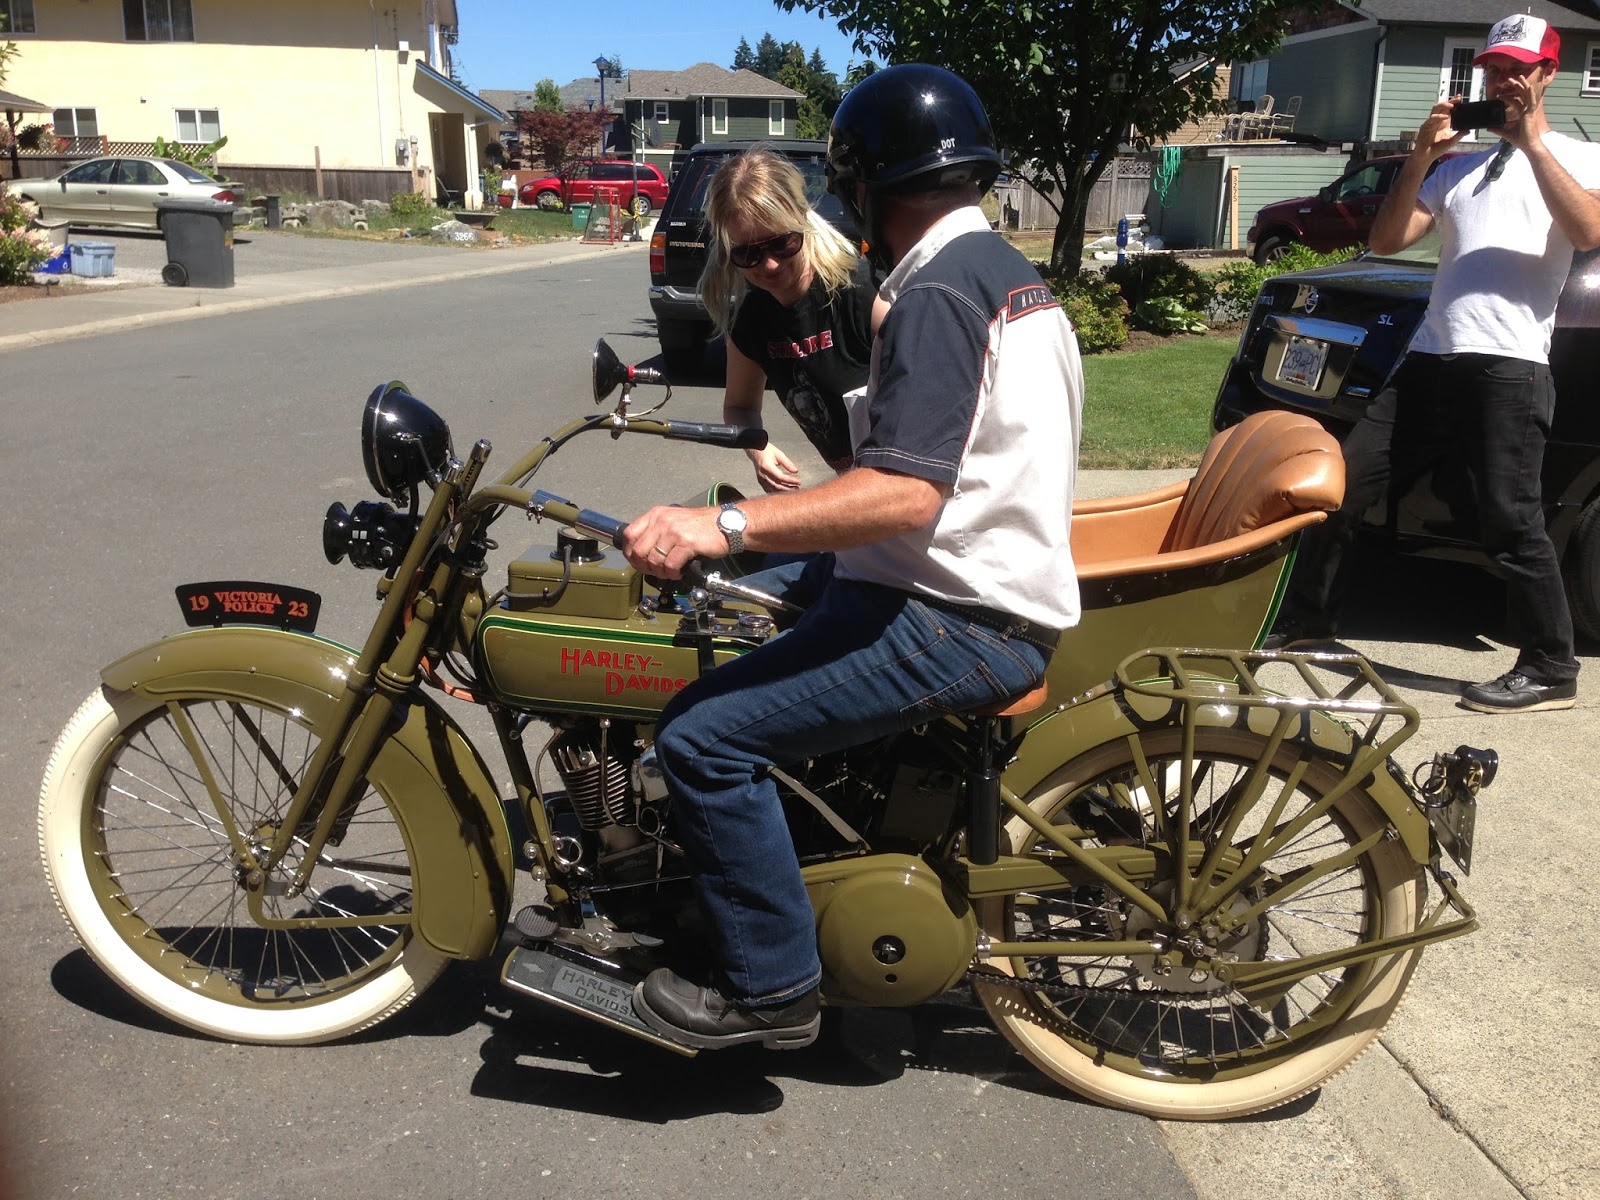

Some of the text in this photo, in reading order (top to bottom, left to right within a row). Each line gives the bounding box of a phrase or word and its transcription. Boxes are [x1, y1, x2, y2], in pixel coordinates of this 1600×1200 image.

[940, 137, 956, 150] DOT
[454, 231, 475, 242] 3266
[1377, 313, 1394, 326] SL
[189, 595, 210, 612] 19
[214, 591, 283, 605] VICTORIA
[223, 601, 275, 615] POLICE
[287, 600, 309, 618] 23
[560, 646, 663, 676] HARLEY-
[562, 969, 633, 1001] HARLEY
